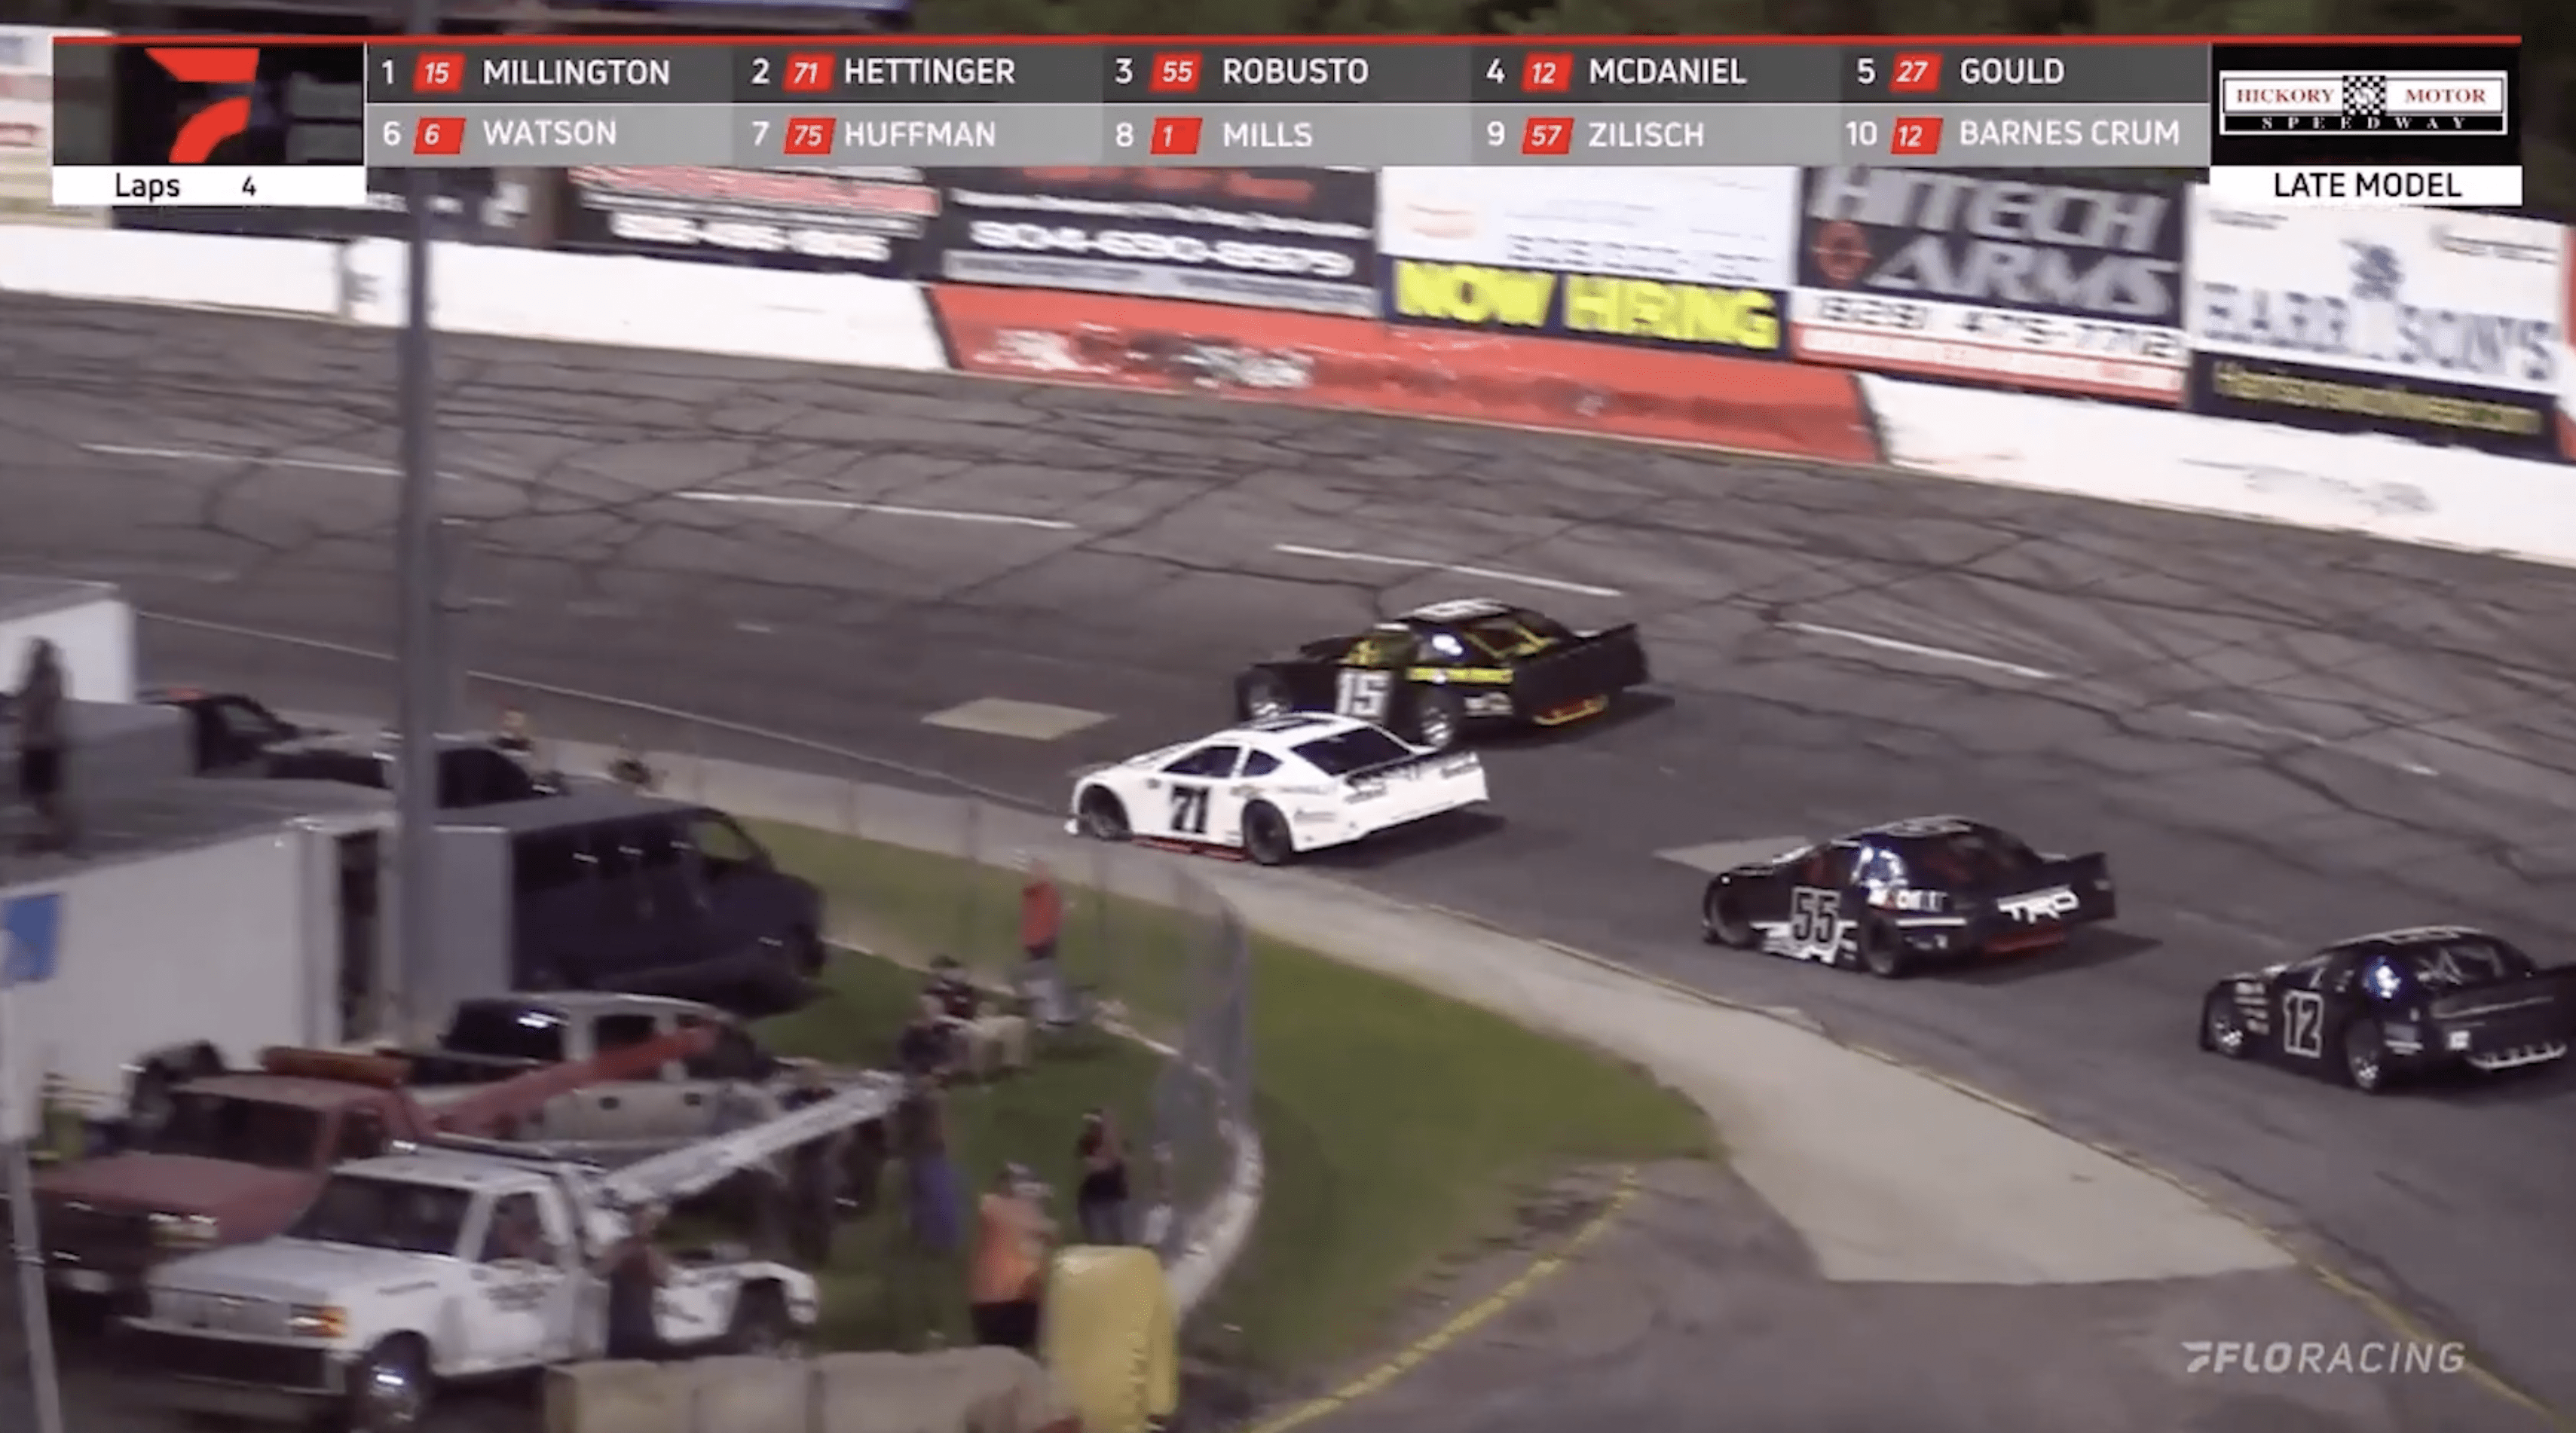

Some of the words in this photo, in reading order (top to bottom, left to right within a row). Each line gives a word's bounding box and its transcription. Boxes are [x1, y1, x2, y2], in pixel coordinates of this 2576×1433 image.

[1807, 167, 2172, 253] HITECH
[1394, 258, 1557, 329] NOW
[1563, 273, 1780, 351] HIRING
[1866, 232, 2183, 317] ARMS
[1334, 668, 1391, 720] 15
[1170, 784, 1210, 834] 71
[1791, 886, 1842, 946] 55
[1997, 884, 2080, 924] TRD
[2283, 989, 2324, 1059] 12
